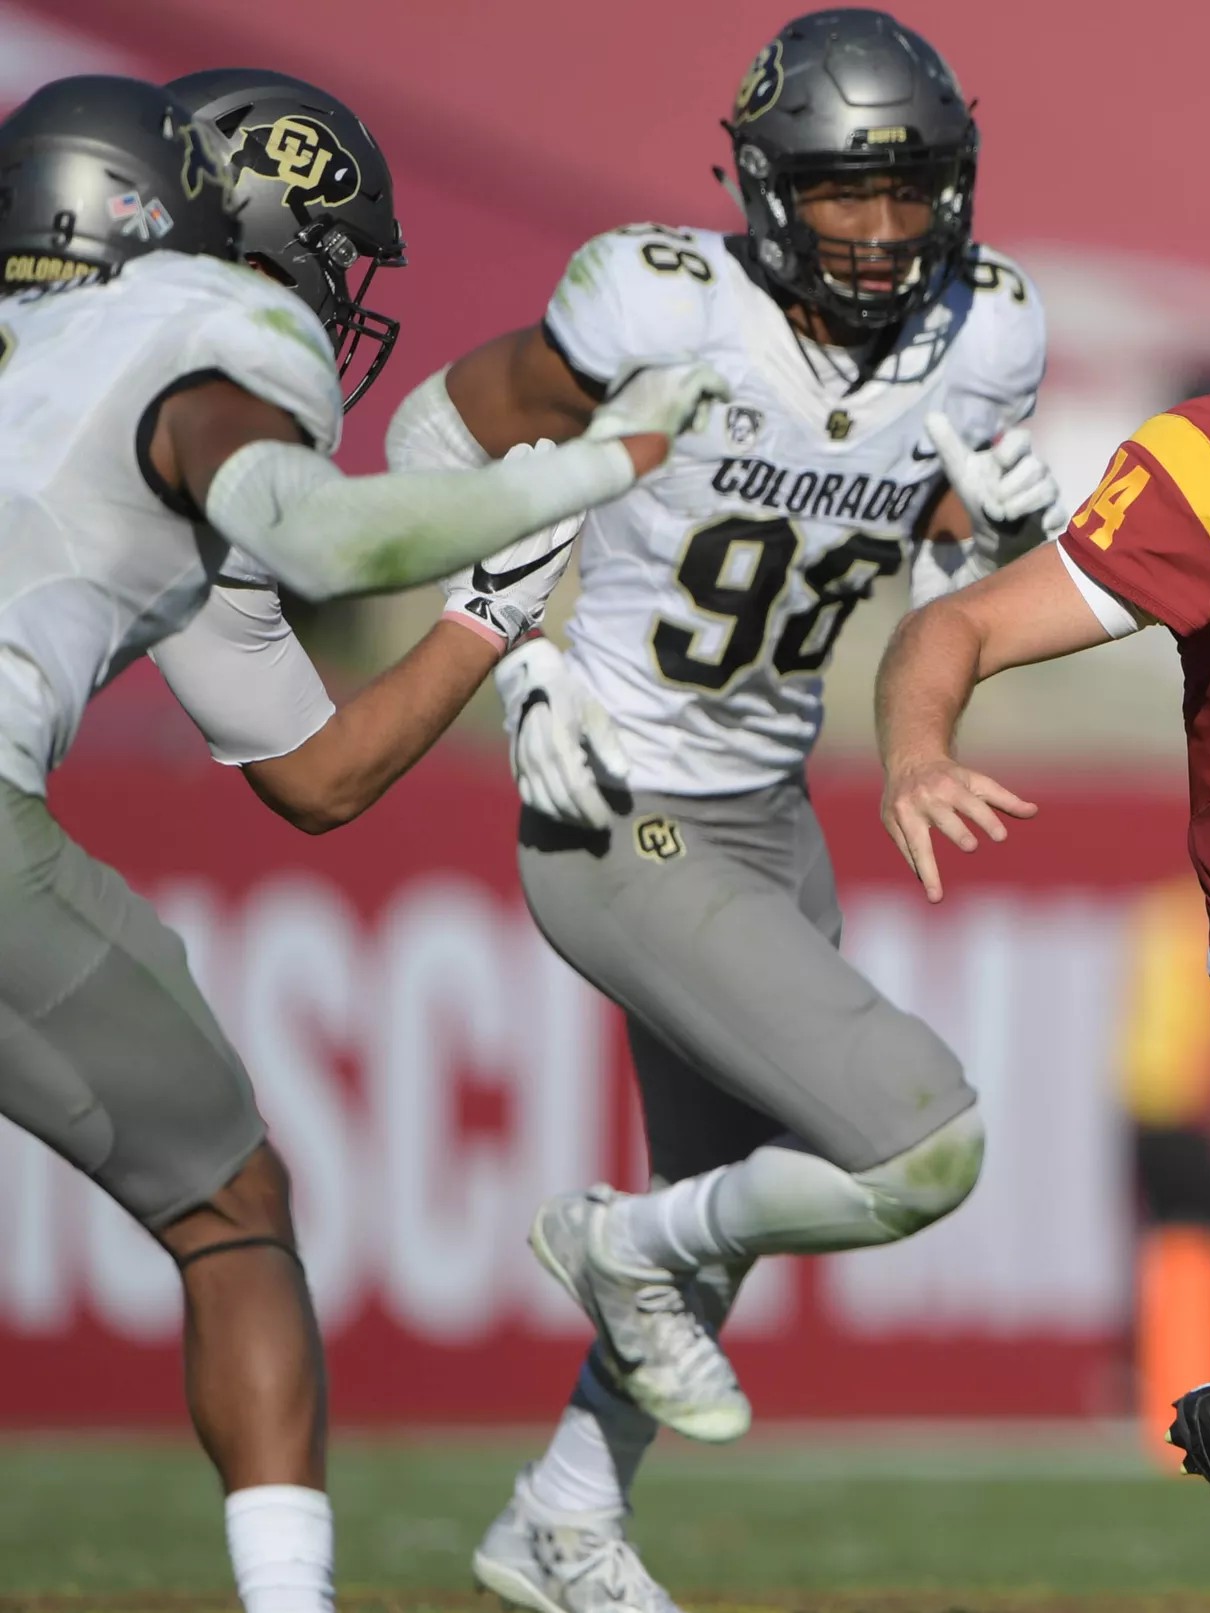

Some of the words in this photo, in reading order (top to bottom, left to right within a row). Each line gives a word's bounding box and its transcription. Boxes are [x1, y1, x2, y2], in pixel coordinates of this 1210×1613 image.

[265, 118, 333, 190] CU
[52, 208, 77, 249] 9
[711, 457, 921, 522] COLORADO
[1071, 447, 1151, 552] 14
[647, 515, 906, 694] 98
[633, 814, 687, 864] CU
